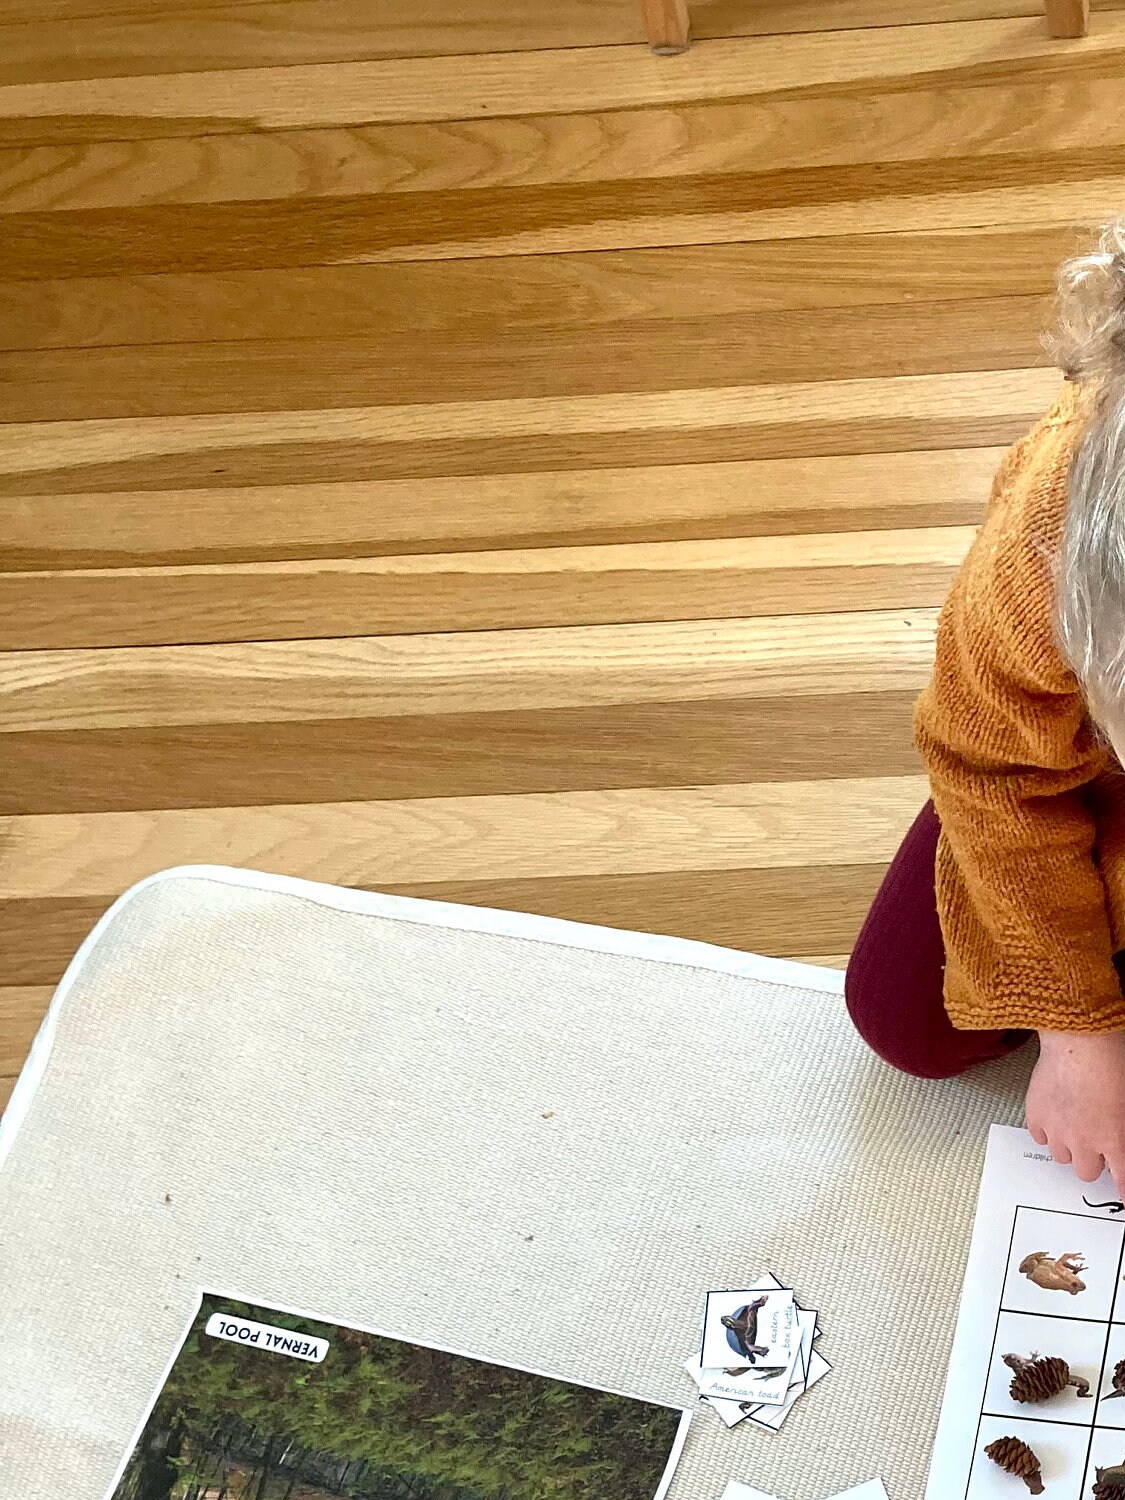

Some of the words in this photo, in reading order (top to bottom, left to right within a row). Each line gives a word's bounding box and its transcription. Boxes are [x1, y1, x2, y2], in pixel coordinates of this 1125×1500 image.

[771, 1311, 779, 1344] eastern
[784, 1305, 793, 1330] turtle
[219, 1321, 261, 1343] POOL
[265, 1332, 318, 1358] VERNAL
[710, 1382, 754, 1397] American
[758, 1389, 781, 1399] toad
